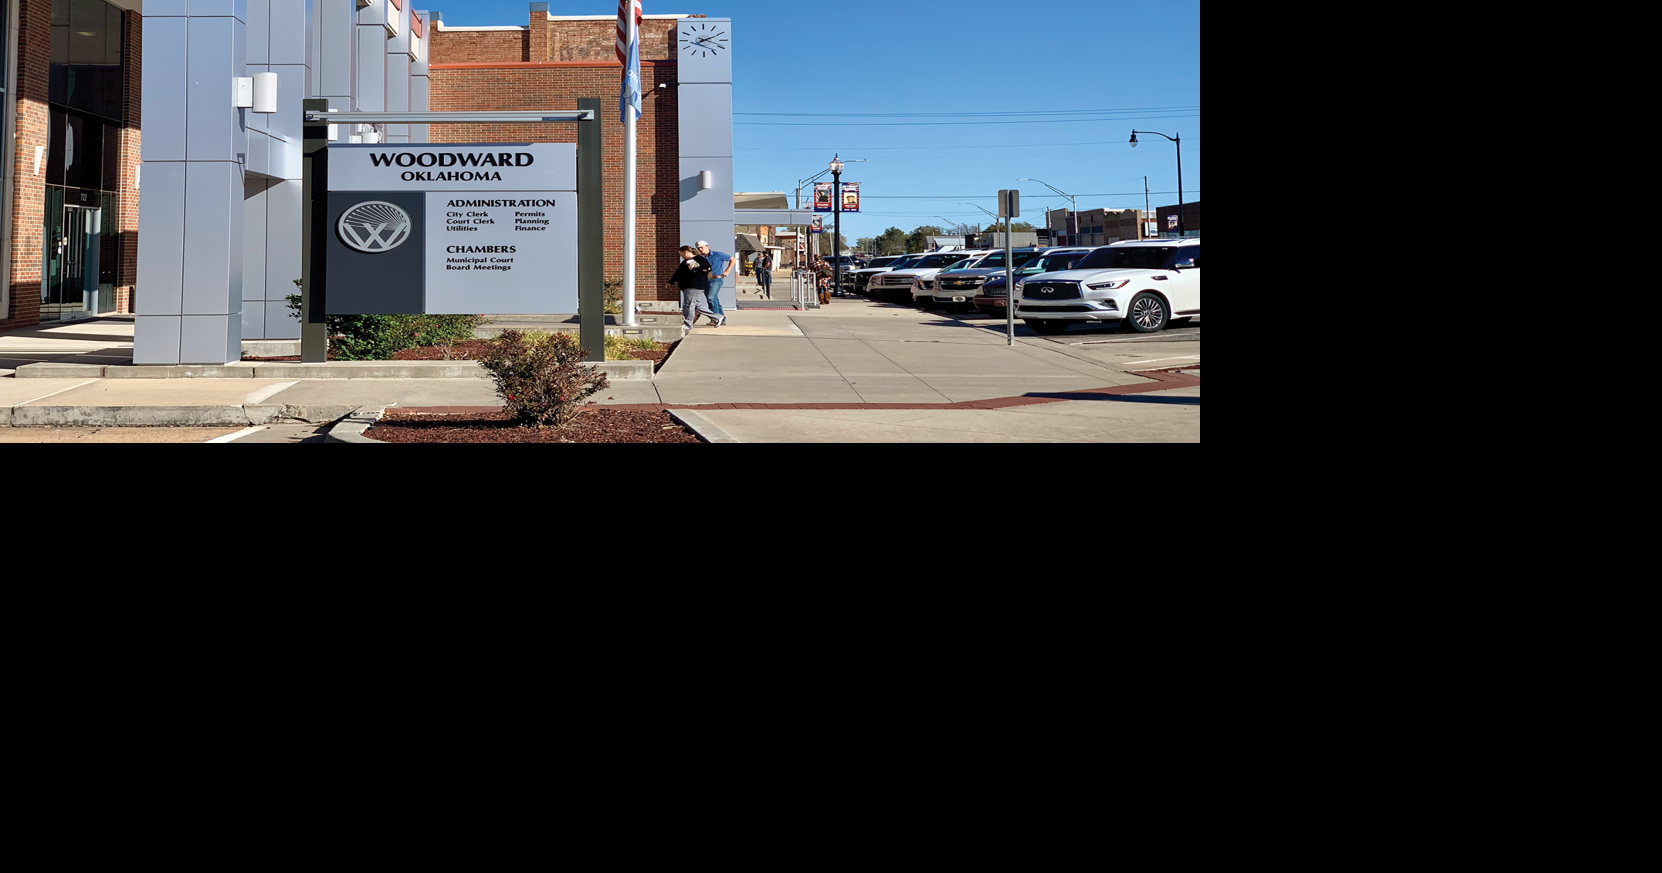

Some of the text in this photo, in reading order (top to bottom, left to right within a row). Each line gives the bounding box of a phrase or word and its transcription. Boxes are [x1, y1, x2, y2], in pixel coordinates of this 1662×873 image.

[369, 153, 534, 168] WOODWARD
[400, 171, 502, 181] OKLAHOMA
[446, 199, 556, 207] ADMINISTRATION
[515, 218, 550, 226] Planning
[446, 245, 517, 253] CHAMBERS
[473, 264, 512, 272] Meetings
